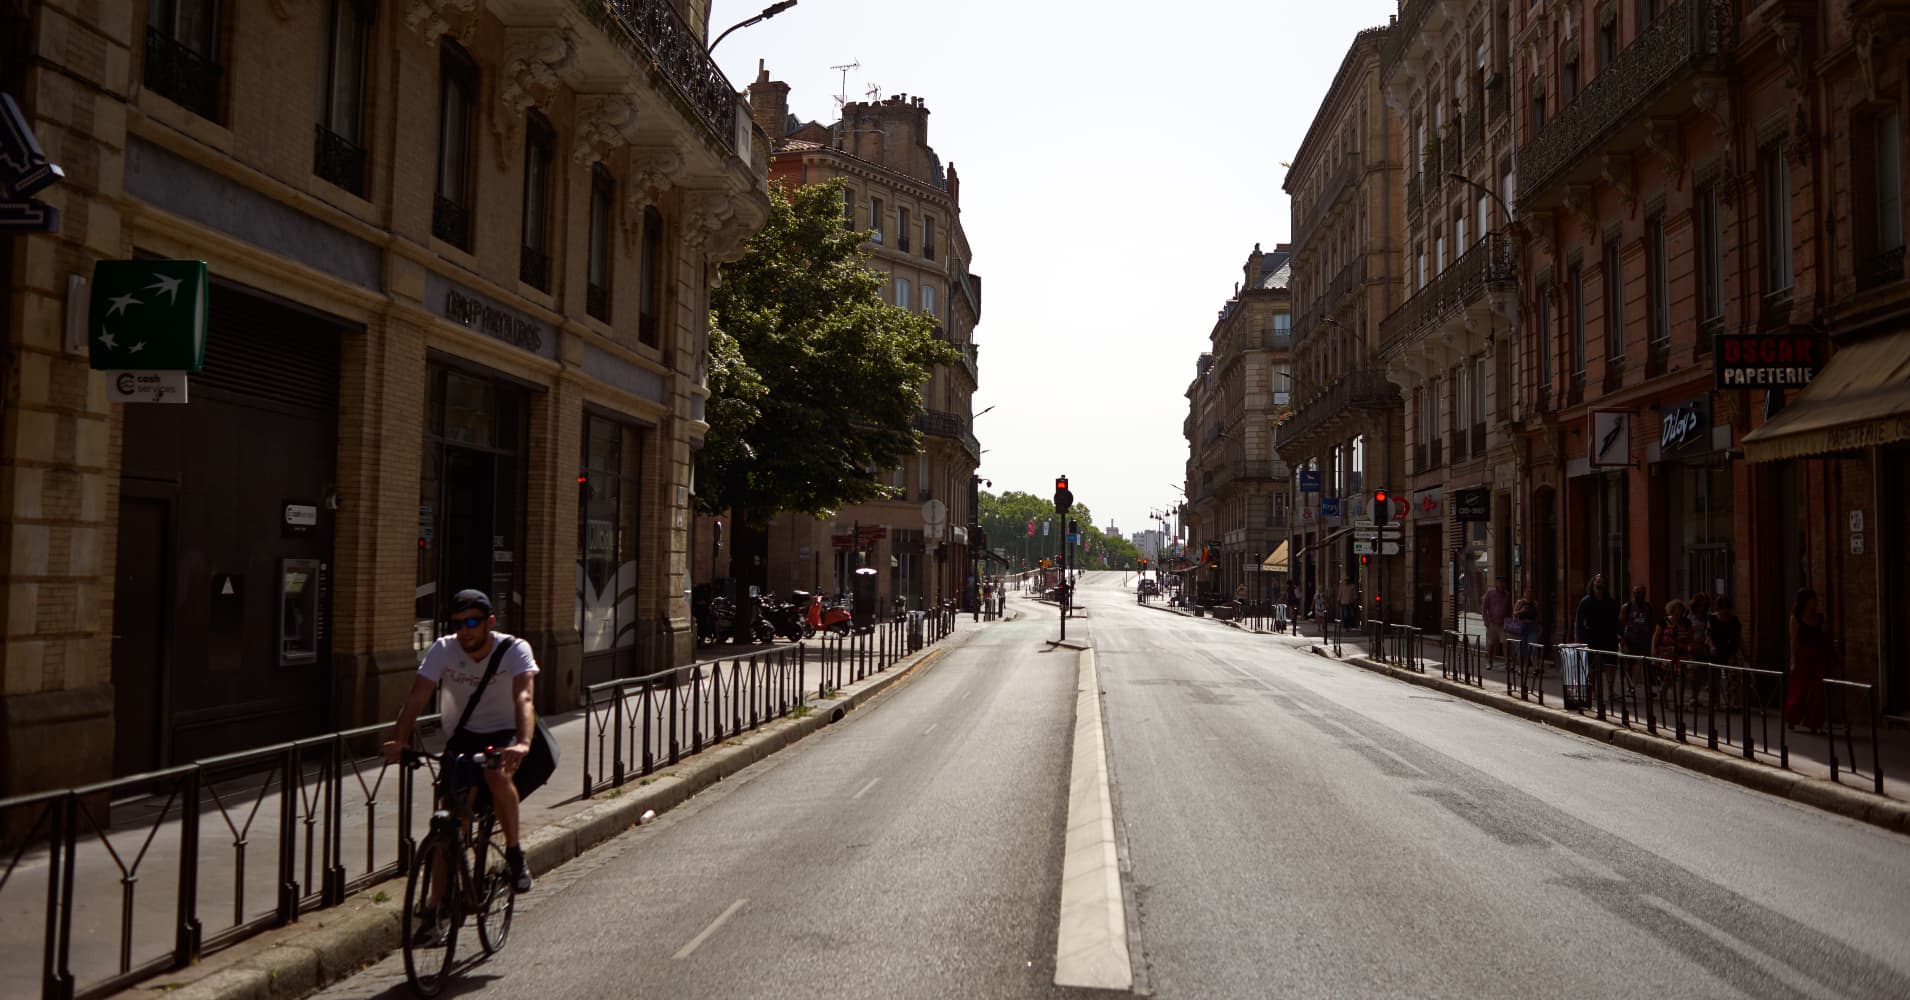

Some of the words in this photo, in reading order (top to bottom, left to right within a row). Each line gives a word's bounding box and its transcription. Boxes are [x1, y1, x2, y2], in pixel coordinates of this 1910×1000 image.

[1723, 337, 1812, 364] OSCAR
[137, 373, 161, 384] cash
[1723, 367, 1813, 385] PAPETERIE
[1827, 422, 1886, 449] PAPETERIE
